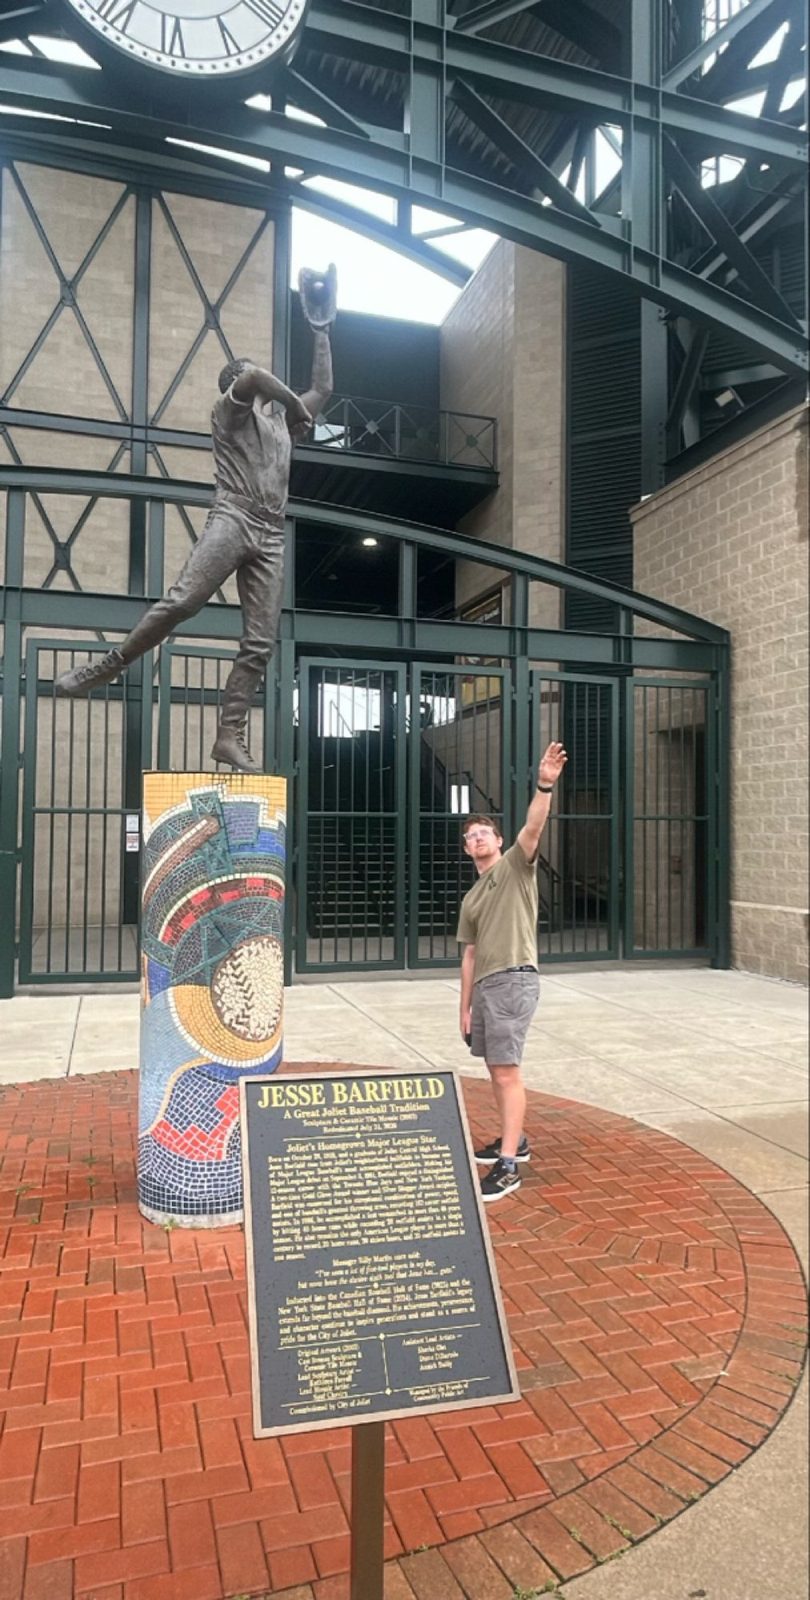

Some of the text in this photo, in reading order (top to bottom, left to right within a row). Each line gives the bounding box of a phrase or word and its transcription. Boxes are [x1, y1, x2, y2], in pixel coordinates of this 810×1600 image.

[258, 1077, 445, 1108] JESSE BARFIELD
[283, 1102, 430, 1118] A Great Joliet Baseball Tradition
[366, 1137, 390, 1148] Major
[391, 1137, 419, 1146] League
[419, 1134, 436, 1143] Star
